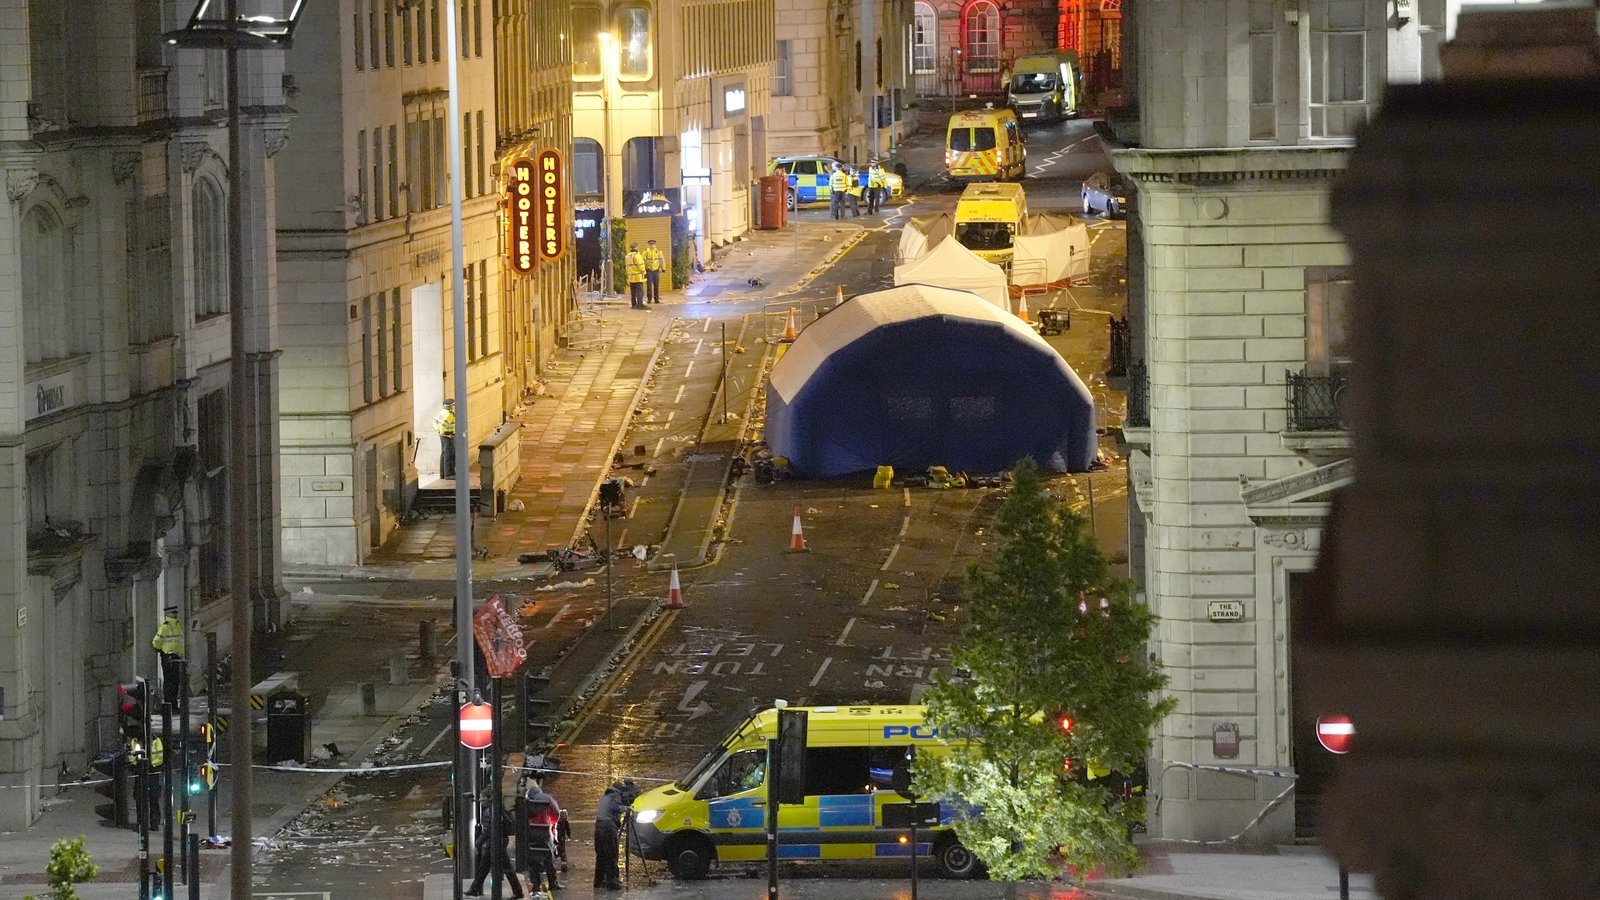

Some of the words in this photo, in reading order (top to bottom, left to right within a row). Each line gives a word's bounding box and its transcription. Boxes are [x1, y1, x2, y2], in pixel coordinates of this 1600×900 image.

[517, 167, 531, 270] HOOTERS
[543, 157, 557, 255] HOOTERS
[652, 661, 768, 676] TURN
